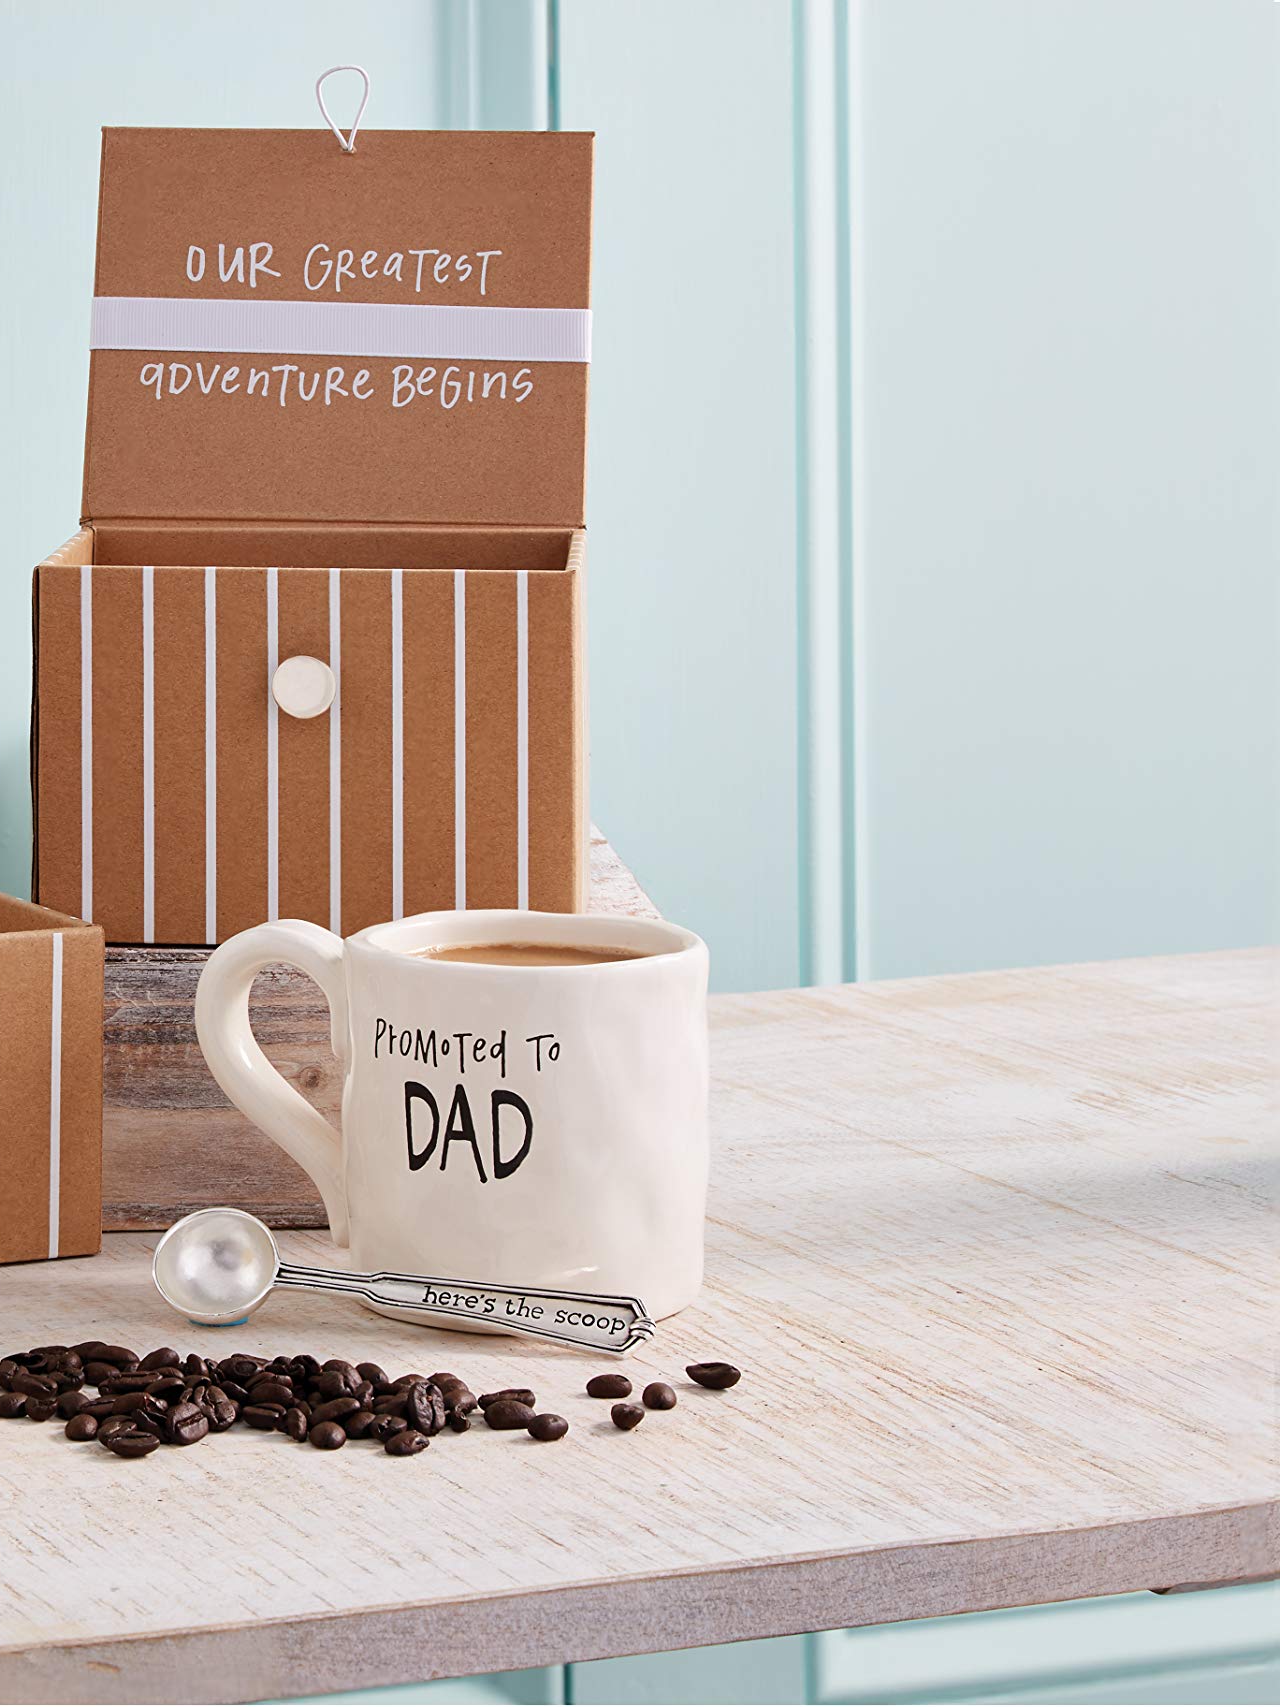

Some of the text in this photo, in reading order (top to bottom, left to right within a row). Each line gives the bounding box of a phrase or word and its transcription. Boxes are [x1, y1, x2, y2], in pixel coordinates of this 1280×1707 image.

[186, 242, 282, 288] OUR
[404, 1080, 533, 1183] DAD
[422, 1284, 626, 1334] here's the scoop
